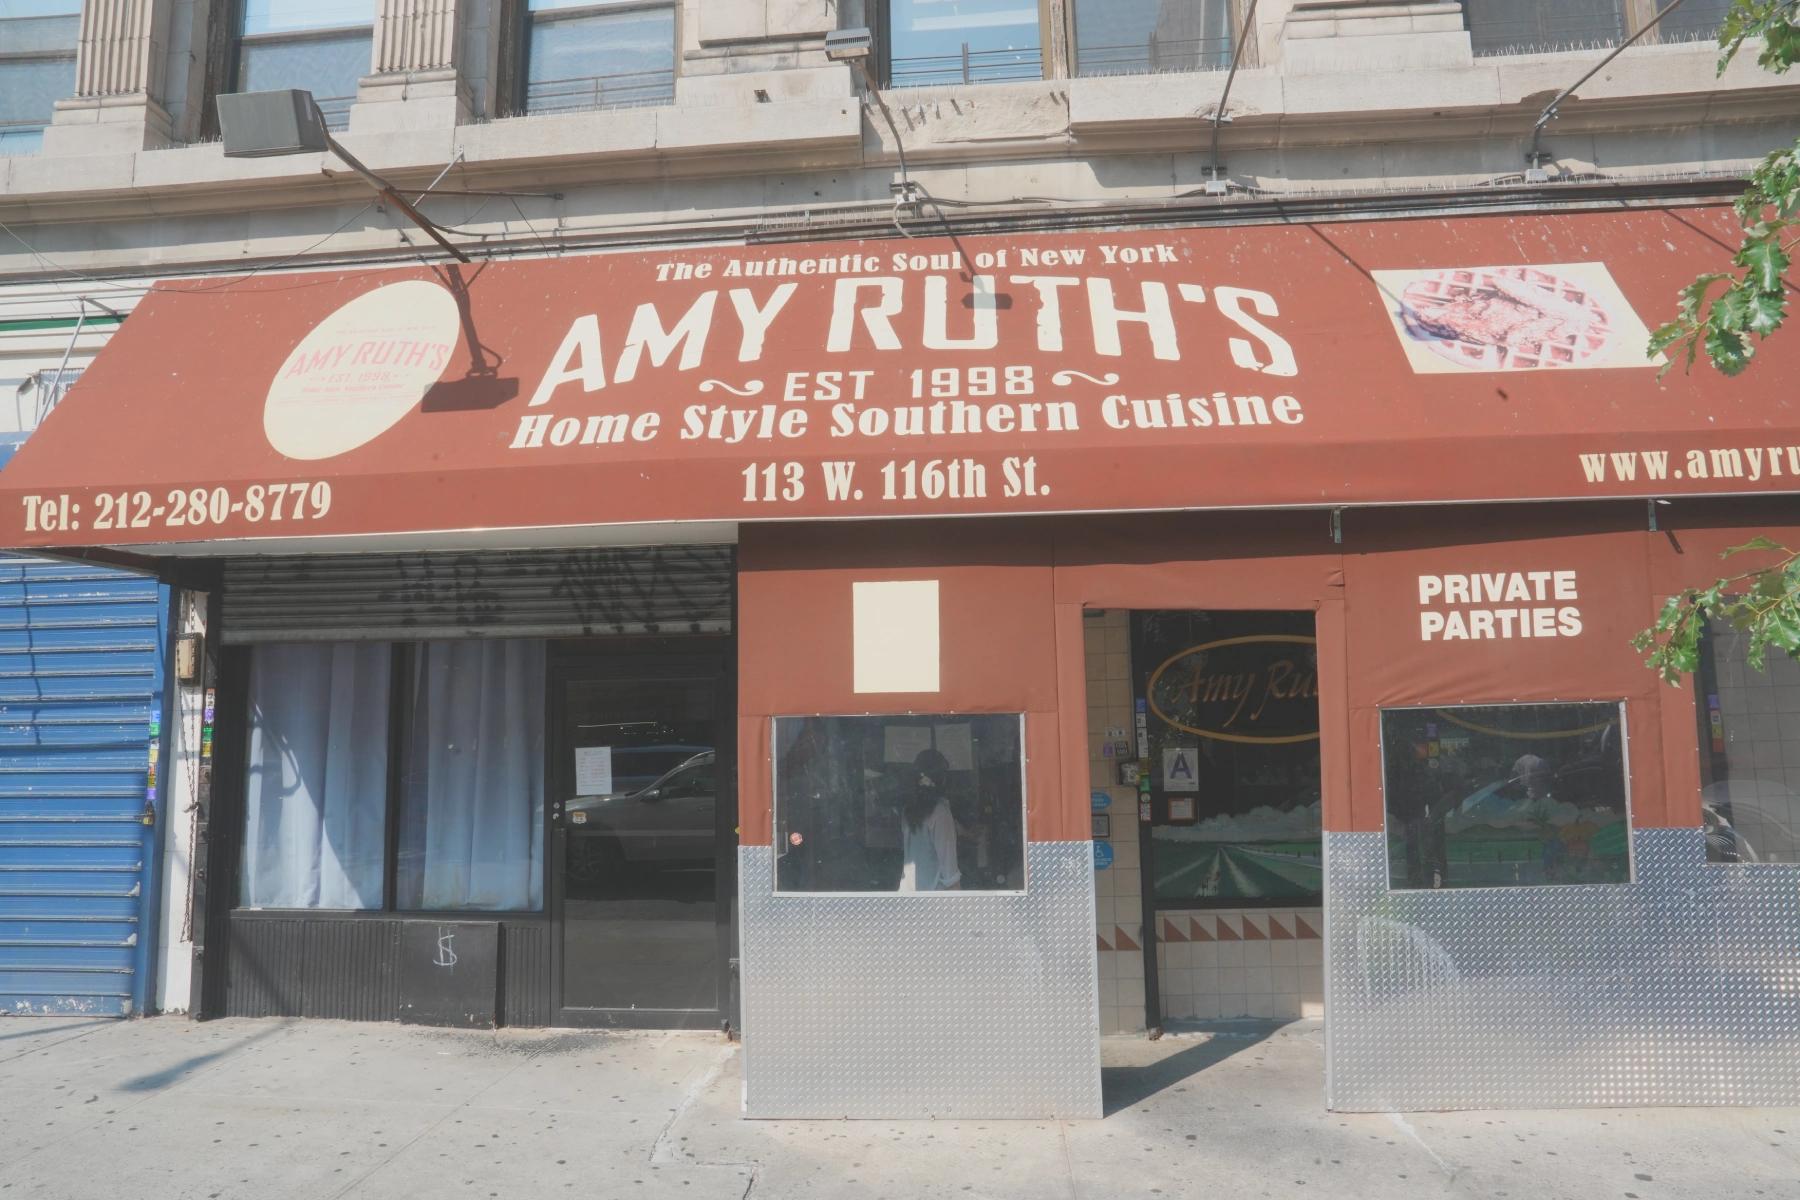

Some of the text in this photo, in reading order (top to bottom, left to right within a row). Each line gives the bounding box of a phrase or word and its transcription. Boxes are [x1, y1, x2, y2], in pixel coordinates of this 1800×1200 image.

[655, 243, 1180, 282] The Authentic Soul of New York
[286, 340, 449, 377] AMY RUTH'S
[527, 274, 1299, 407] AMY RUTH'S
[783, 365, 1035, 402] EST 1998
[508, 392, 1305, 449] Home Style Southern Cuisine
[741, 455, 1051, 502] 113 W. 116th St.
[23, 481, 332, 532] Tel: 212-280-8779
[1418, 570, 1578, 604] PRIVATE
[1420, 606, 1583, 641] PARTIES
[1170, 656, 1320, 728] Amy Ru
[1170, 751, 1193, 780] A
